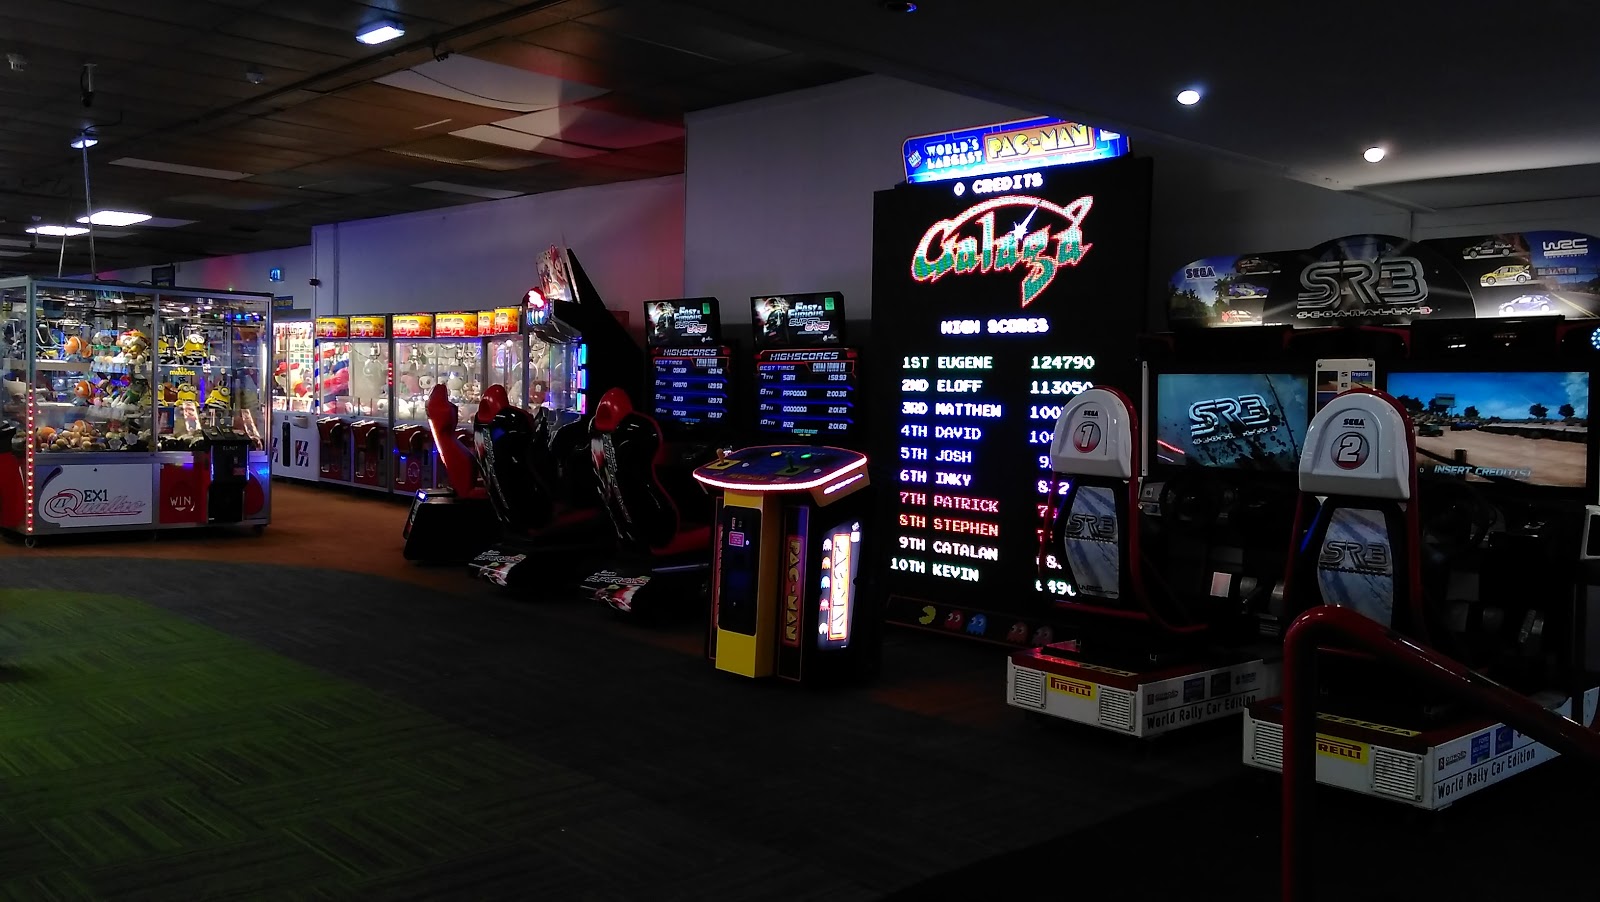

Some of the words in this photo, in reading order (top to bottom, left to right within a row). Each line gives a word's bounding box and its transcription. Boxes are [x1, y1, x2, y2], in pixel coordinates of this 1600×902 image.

[926, 139, 979, 156] WORLD'S
[987, 124, 1092, 158] PAC-MAN
[927, 150, 983, 170] LARGEST
[972, 172, 1043, 195] CREDITS
[911, 195, 1093, 308] Galaga
[1542, 238, 1588, 250] WRC
[1185, 266, 1216, 279] SEGA
[1297, 257, 1428, 309] SR3
[788, 309, 824, 318] FURIOUS
[795, 302, 817, 311] FAST
[789, 317, 820, 326] SUPER
[805, 321, 830, 331] CARS
[941, 319, 980, 335] HIGH
[987, 318, 1049, 334] SCORES
[770, 352, 839, 361] HIGHSCORES
[902, 356, 929, 369] 1ST
[937, 356, 993, 369] EUGENE
[1030, 355, 1095, 370] 124790
[901, 379, 929, 392] 2ND
[937, 379, 983, 393] ELOFF
[901, 402, 928, 415] 3RD
[935, 403, 1001, 418] MATTHEW
[1188, 394, 1270, 437] SR3
[1343, 418, 1365, 426] SEGA
[901, 425, 928, 437] 4TH
[935, 426, 981, 440] DAVID
[1080, 424, 1094, 448] 1
[900, 447, 927, 460] 5TH
[935, 449, 971, 463] JOSH
[1336, 434, 1362, 463] 2
[900, 470, 927, 483] 6TH
[935, 472, 971, 486] INKY
[1433, 464, 1472, 475] INSERT
[84, 489, 108, 502] EX1
[170, 496, 191, 506] WIN
[899, 492, 926, 506] 7TH
[933, 495, 999, 513] PATRICK
[899, 514, 926, 528] 8TH
[933, 518, 999, 537] STEPHEN
[898, 537, 925, 551] 9TH
[932, 541, 999, 561] CATALAN
[1319, 540, 1389, 569] SR3
[890, 558, 926, 574] 10TH
[932, 563, 980, 582] KEVIN
[786, 540, 800, 641] PAC-MAN
[1050, 677, 1091, 697] PIRELLI
[1147, 712, 1175, 729] World
[1180, 705, 1203, 721] Rally
[1206, 702, 1221, 715] Car
[1225, 694, 1257, 710] Edition
[1316, 738, 1362, 760] RELLI
[1437, 775, 1464, 800] World
[1466, 766, 1489, 787] Rally
[1491, 761, 1505, 776] Car
[1507, 752, 1536, 774] Edition
